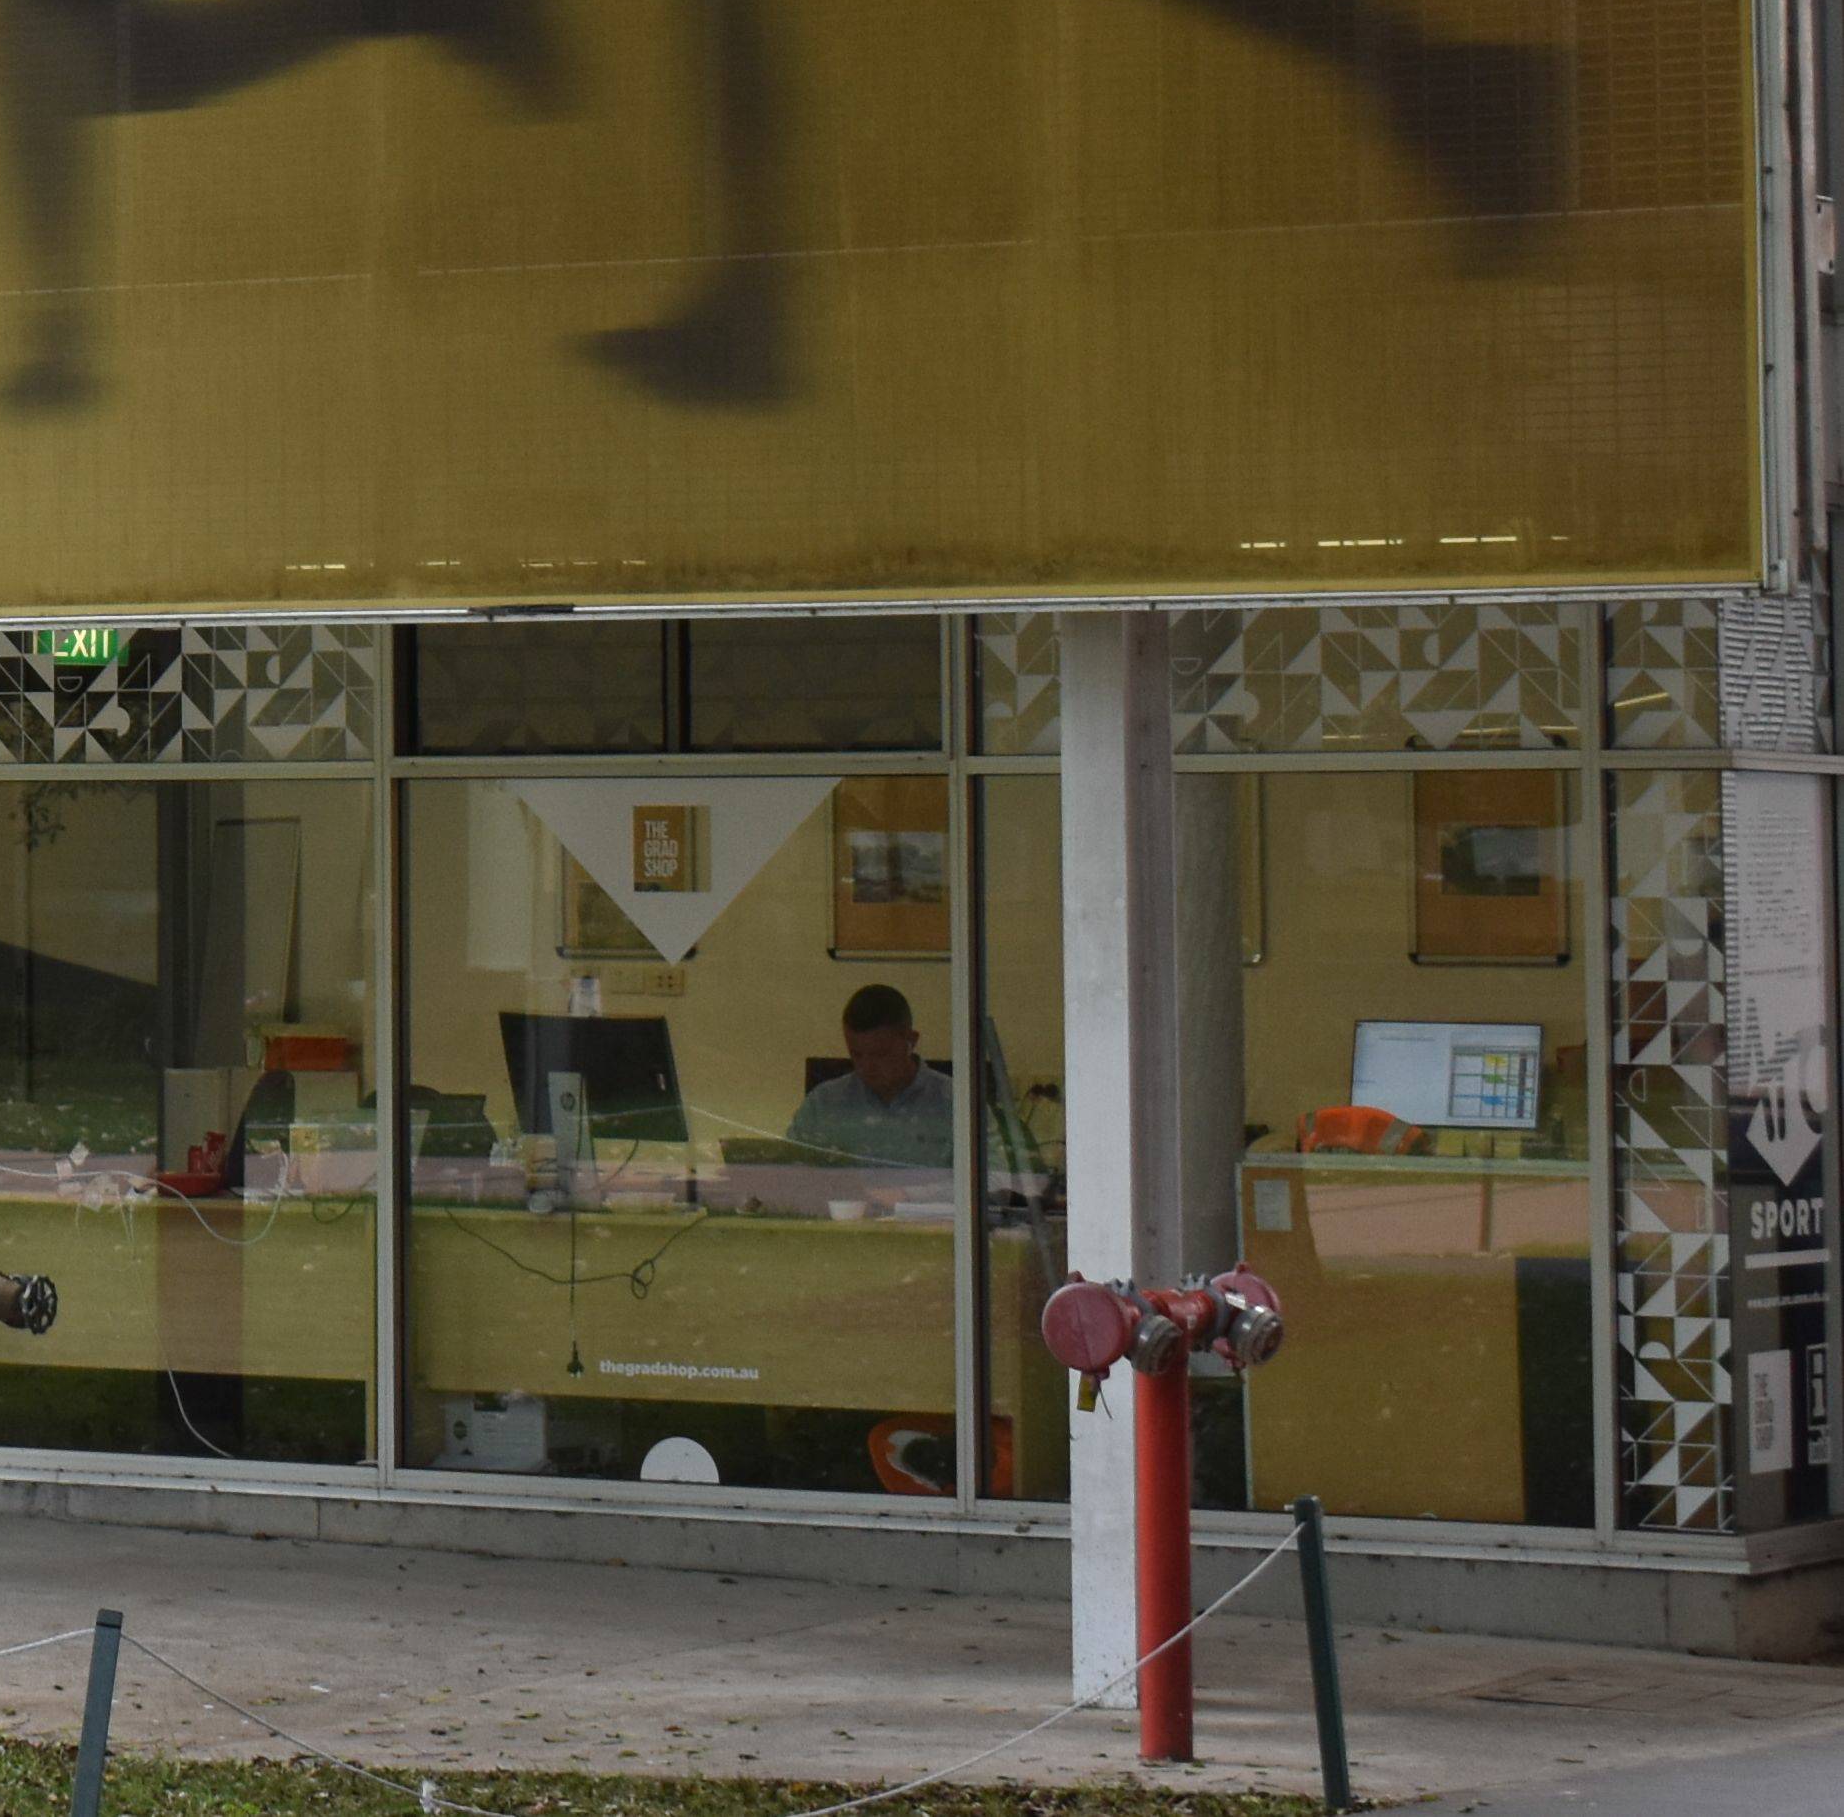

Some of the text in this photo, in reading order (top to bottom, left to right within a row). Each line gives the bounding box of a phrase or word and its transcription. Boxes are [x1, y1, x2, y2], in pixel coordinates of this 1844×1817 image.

[644, 821, 670, 839] THE
[644, 859, 678, 877] SHOP
[1750, 1197, 1824, 1240] SPORT
[600, 1360, 760, 1379] thegradshop.com.au
